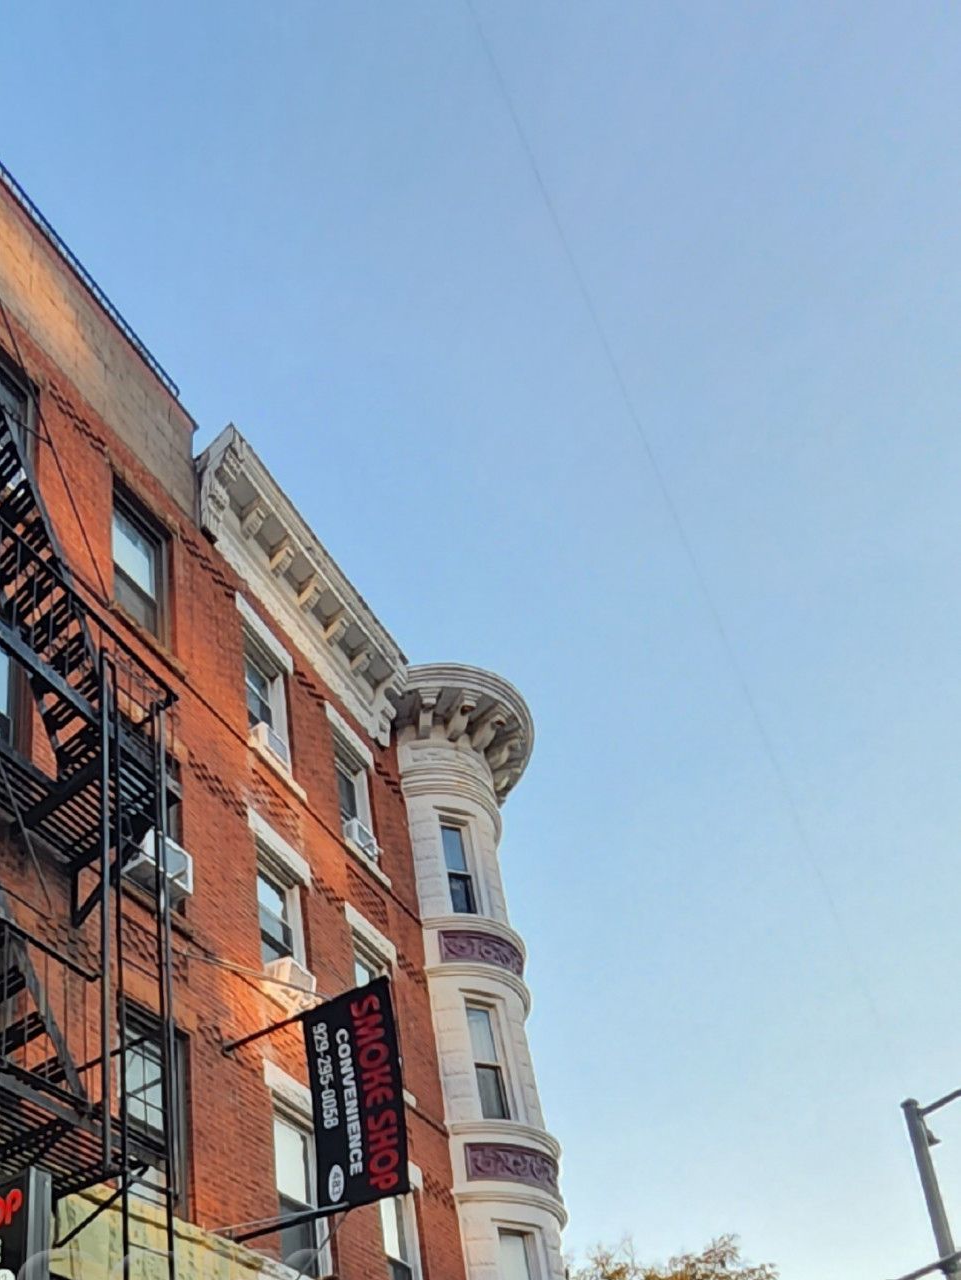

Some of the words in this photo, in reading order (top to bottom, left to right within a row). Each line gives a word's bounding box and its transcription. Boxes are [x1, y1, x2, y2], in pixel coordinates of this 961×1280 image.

[312, 1022, 339, 1130] 929-295-0058
[336, 1028, 363, 1176] CONVENIENCE
[350, 994, 394, 1107] SMOKE
[367, 1108, 399, 1190] SHOP
